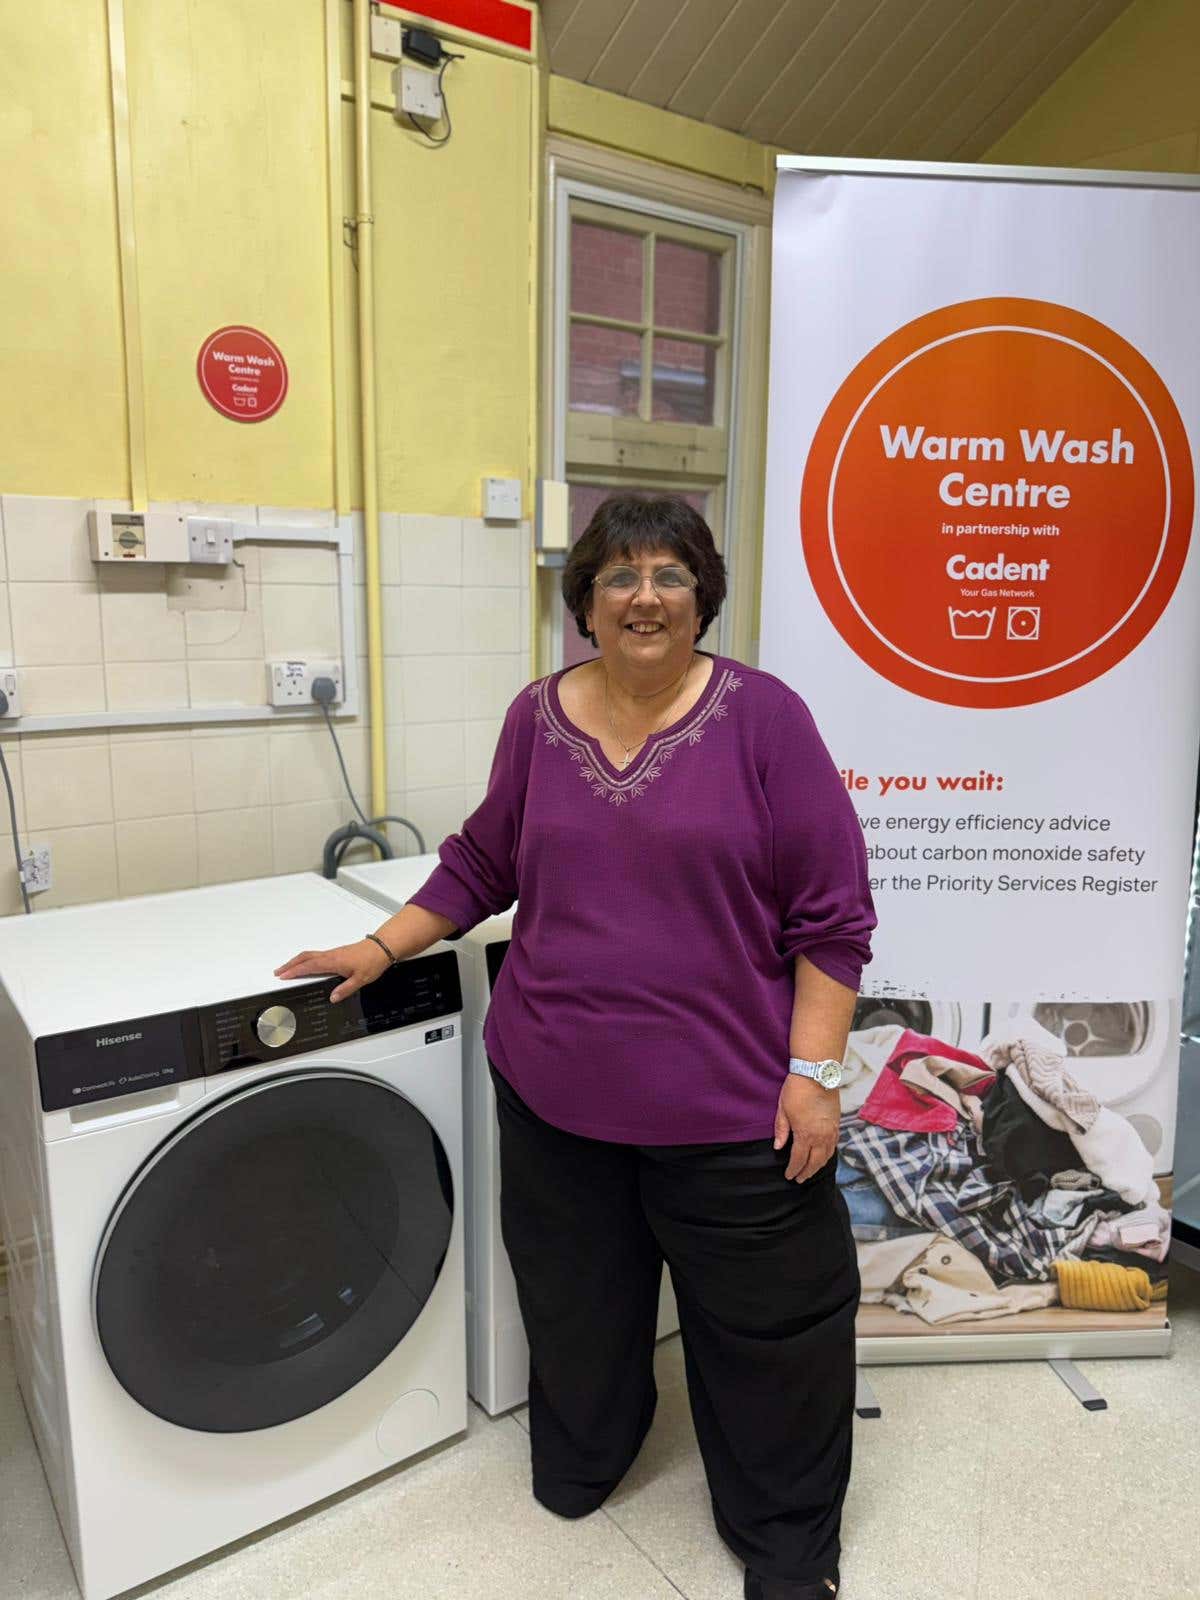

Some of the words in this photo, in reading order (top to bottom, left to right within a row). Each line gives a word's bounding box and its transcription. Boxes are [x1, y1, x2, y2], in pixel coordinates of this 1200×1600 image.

[213, 351, 244, 363] Warm
[246, 355, 275, 366] Wash
[228, 363, 261, 376] Centre
[880, 424, 1005, 461] Warm
[1019, 428, 1134, 464] Wash
[938, 472, 1071, 509] Centre
[941, 522, 954, 534] in
[956, 523, 1030, 537] partnership
[1032, 525, 1060, 536] with
[945, 553, 1050, 581] Cadent
[960, 588, 979, 597] Your
[981, 588, 998, 597] Gas
[999, 589, 1035, 598] Network
[840, 768, 869, 791] ile
[878, 775, 927, 797] you
[936, 770, 1004, 792] wait:
[885, 817, 950, 834] energy
[955, 814, 1045, 834] efficiency
[1049, 815, 1111, 832] advice
[865, 844, 917, 860] about
[922, 845, 987, 861] carbon
[992, 845, 1082, 861] monoxide
[1087, 845, 1146, 866] safety
[869, 878, 887, 890] er
[892, 874, 921, 890] the
[927, 874, 993, 894] Priority
[998, 875, 1077, 892] Services
[1082, 876, 1158, 895] Register
[95, 1032, 143, 1048] Hisense
